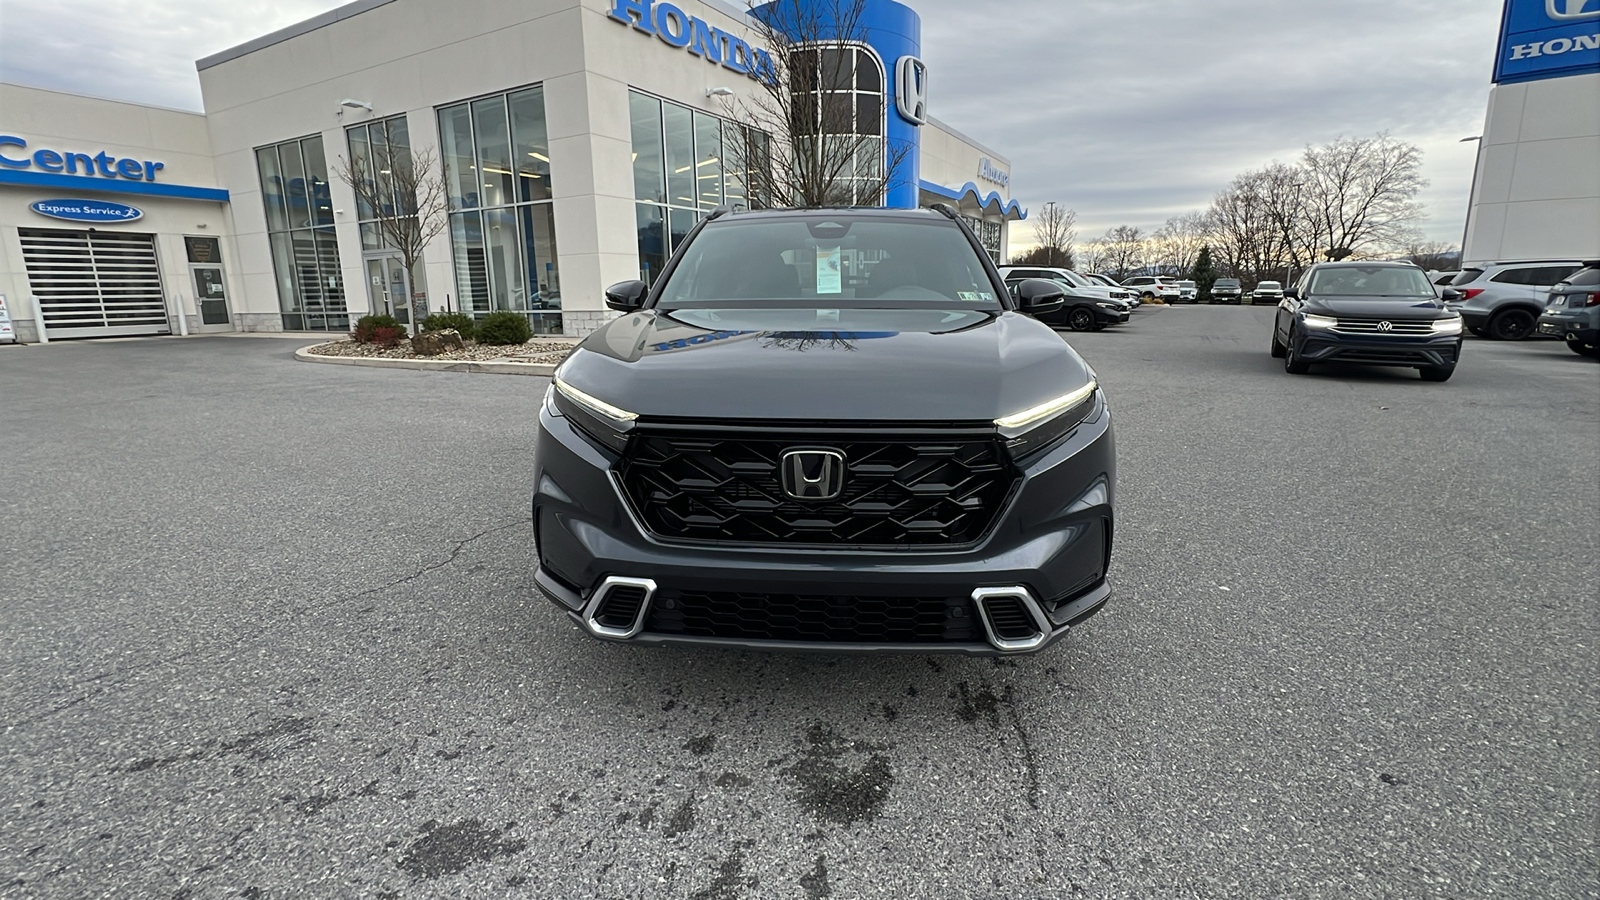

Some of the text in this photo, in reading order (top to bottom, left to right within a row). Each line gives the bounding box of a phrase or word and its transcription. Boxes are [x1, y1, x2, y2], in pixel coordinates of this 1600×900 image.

[608, 0, 780, 88] HONDA
[0, 135, 164, 181] Center
[38, 203, 122, 215] Express Service
